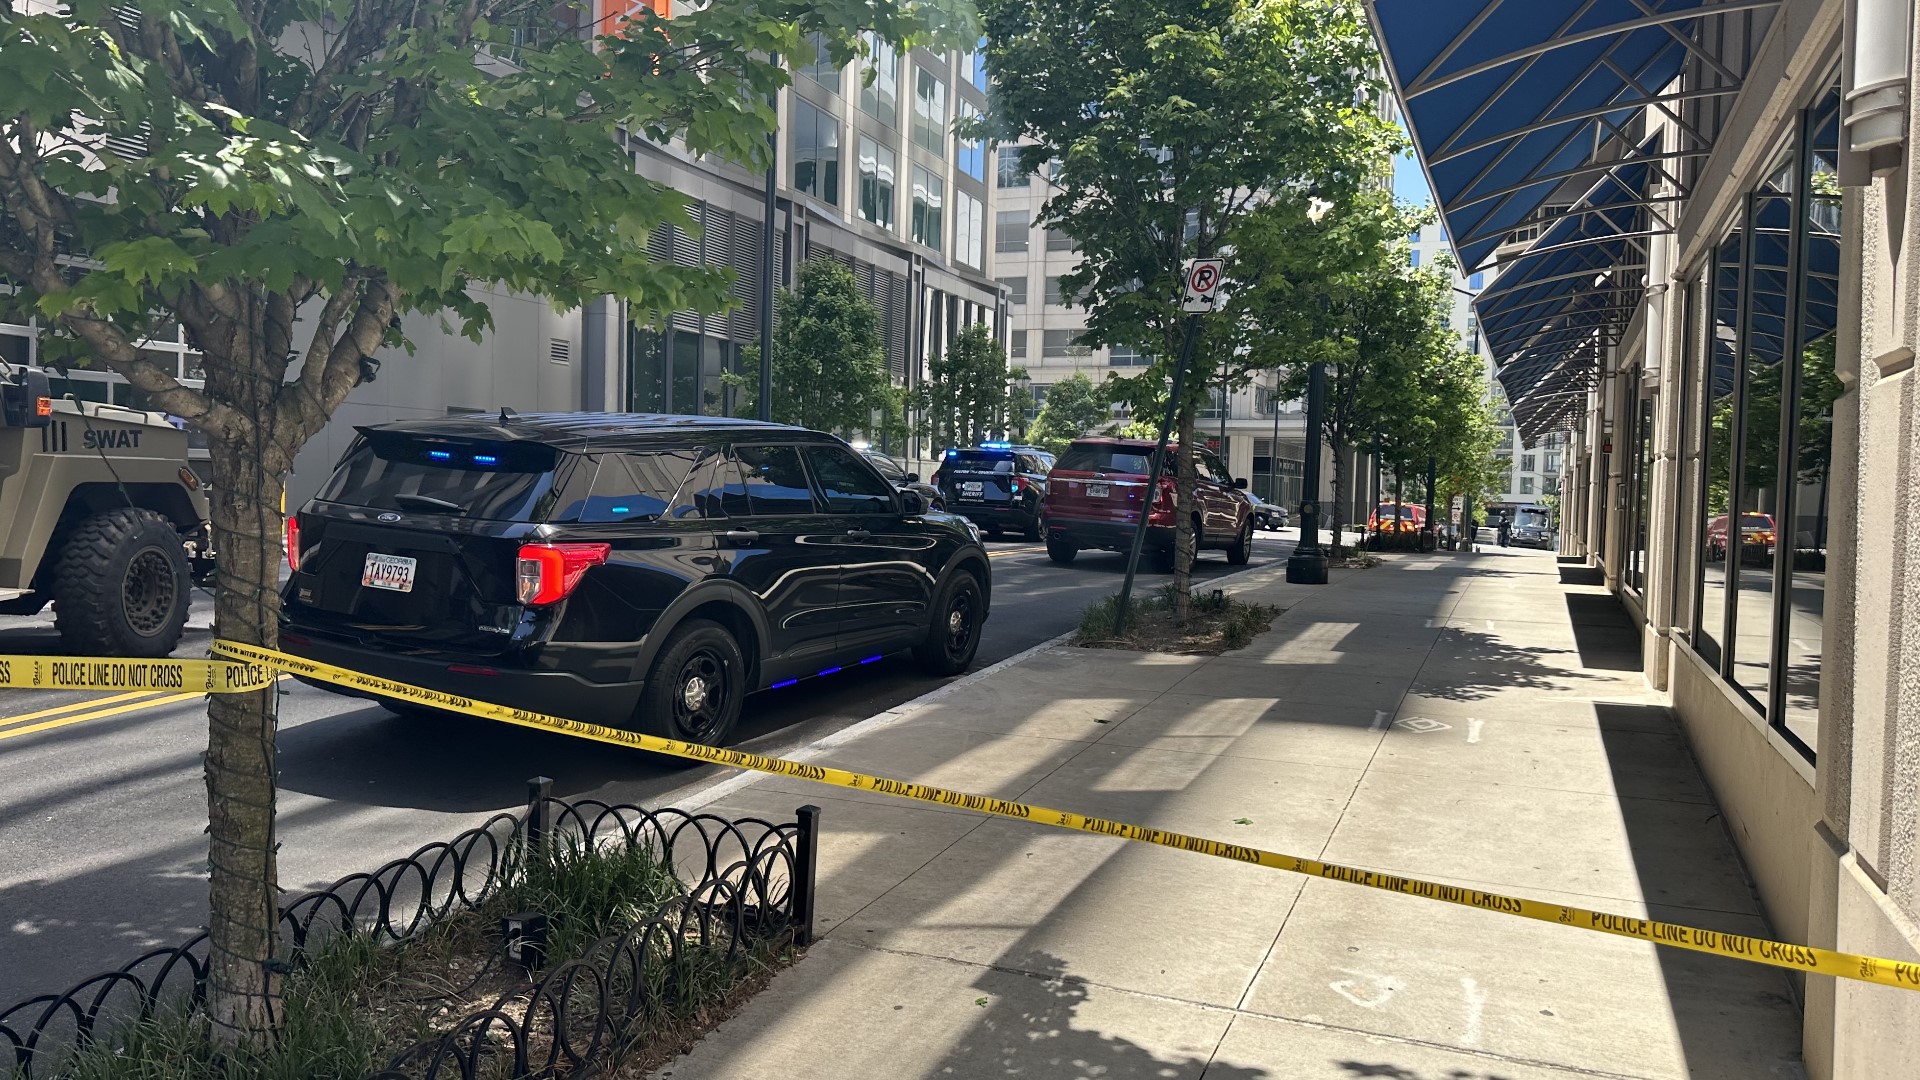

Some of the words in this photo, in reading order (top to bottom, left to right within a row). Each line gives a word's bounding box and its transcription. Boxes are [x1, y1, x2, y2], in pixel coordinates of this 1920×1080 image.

[83, 429, 143, 449] SWAT
[370, 562, 410, 583] TAY9793
[385, 557, 413, 566] GEORGIA
[52, 662, 86, 686] POLICE
[88, 663, 110, 686] LINE
[112, 664, 126, 687] DO
[128, 664, 148, 687] NOT
[150, 665, 183, 688] CROSS
[226, 664, 264, 688] POLICE
[1591, 911, 1648, 937] POLICE
[1652, 922, 1689, 944] LINE
[1693, 929, 1717, 949] DO
[1721, 933, 1753, 956] NOT
[1758, 940, 1818, 967] CROSS
